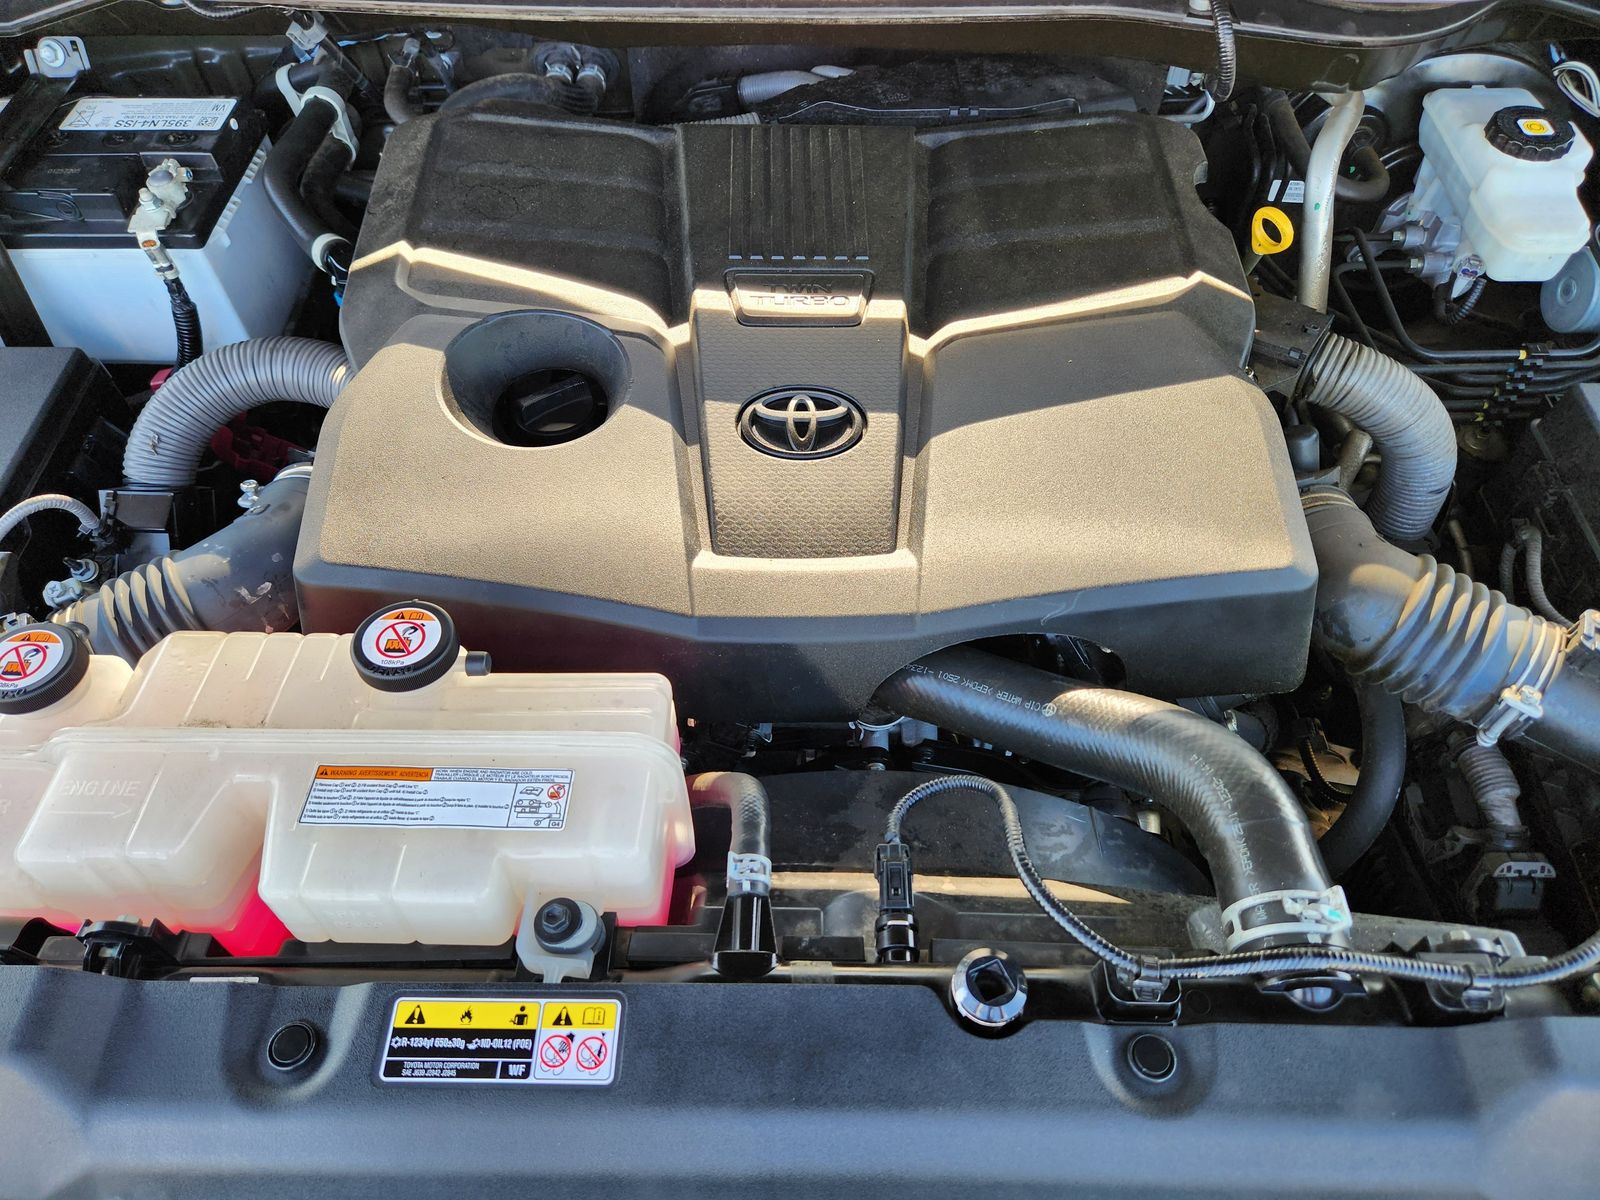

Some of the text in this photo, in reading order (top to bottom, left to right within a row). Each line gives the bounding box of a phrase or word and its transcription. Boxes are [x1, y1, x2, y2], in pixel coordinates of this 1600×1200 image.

[114, 119, 191, 128] 395LN4-ISS
[763, 283, 834, 293] TWIN
[750, 295, 850, 305] TURBO
[938, 670, 960, 684] 2501
[996, 690, 1023, 705] WATER
[60, 780, 141, 796] ENGINE
[401, 1037, 434, 1049] R-1234yf
[403, 1061, 480, 1070] TOYOTA MOTOR CORPORATION
[508, 1064, 526, 1076] WF
